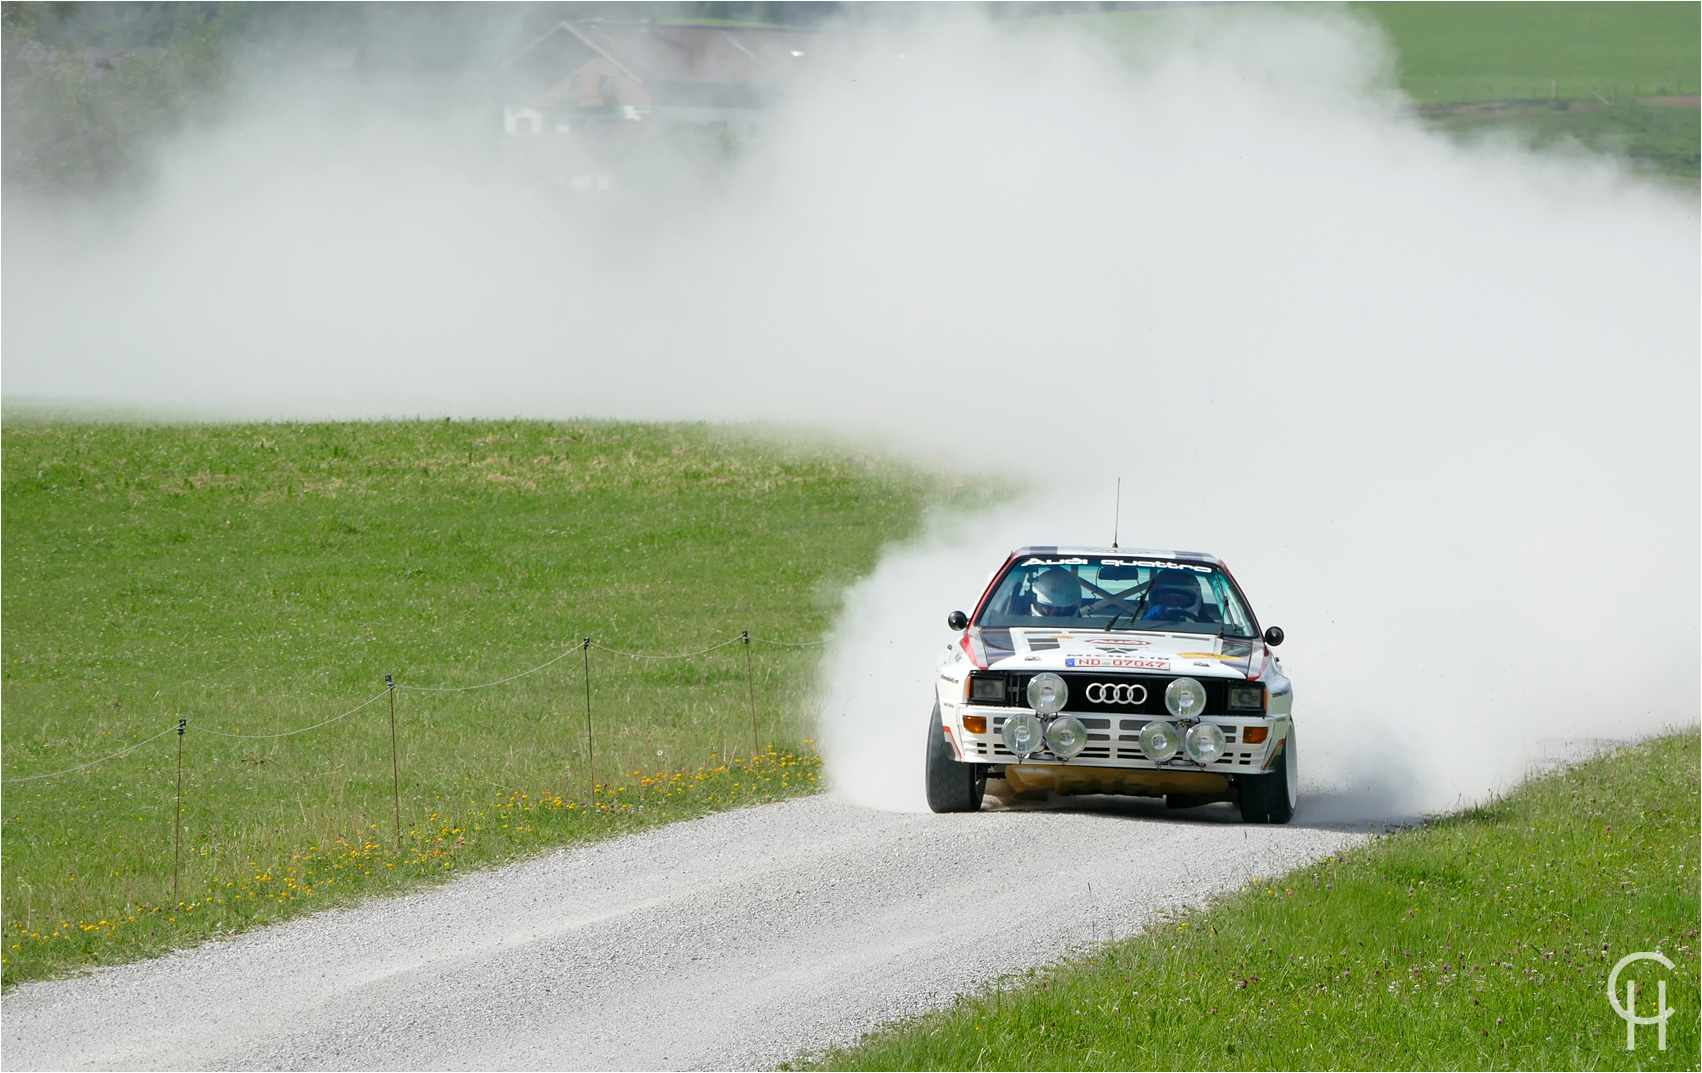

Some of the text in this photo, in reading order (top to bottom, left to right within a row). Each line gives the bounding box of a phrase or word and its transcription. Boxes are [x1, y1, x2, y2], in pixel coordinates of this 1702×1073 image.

[1021, 557, 1212, 573] Audi quattro
[1113, 659, 1165, 668] 07047
